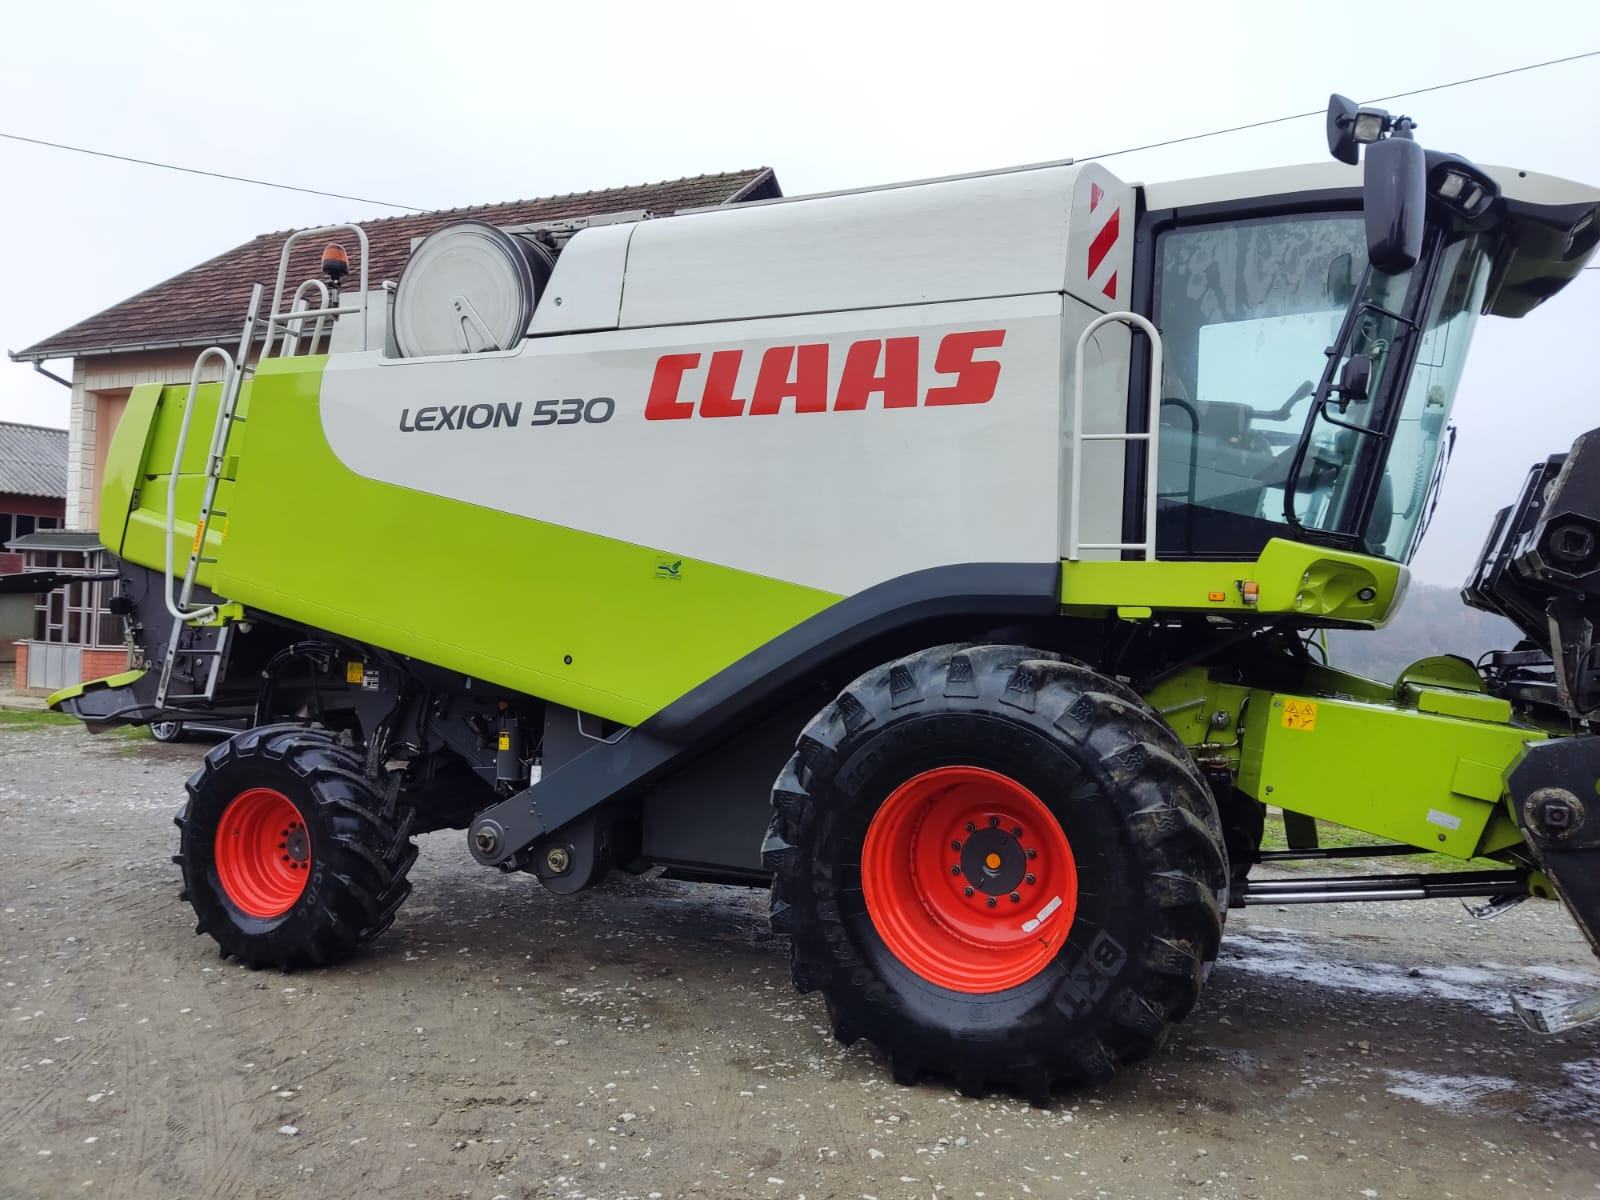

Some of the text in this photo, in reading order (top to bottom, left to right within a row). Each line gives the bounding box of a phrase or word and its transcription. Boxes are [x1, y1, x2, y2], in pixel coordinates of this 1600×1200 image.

[399, 397, 615, 432] LEXION 530
[644, 329, 1006, 421] CLAAS
[1055, 929, 1128, 1020] BKT
